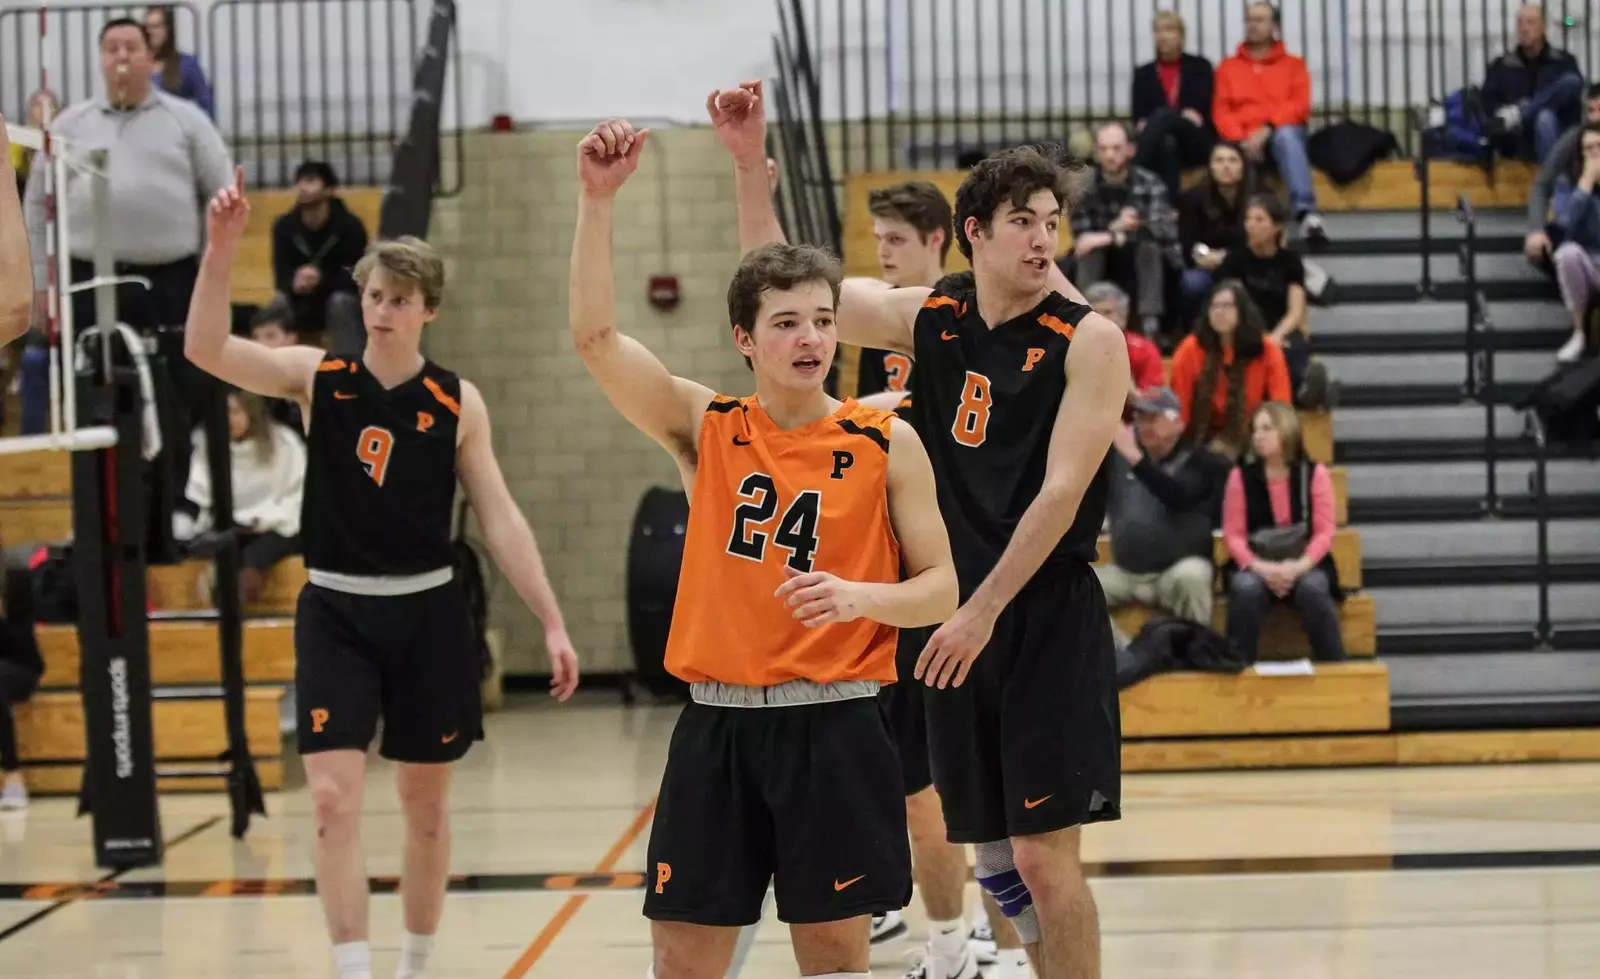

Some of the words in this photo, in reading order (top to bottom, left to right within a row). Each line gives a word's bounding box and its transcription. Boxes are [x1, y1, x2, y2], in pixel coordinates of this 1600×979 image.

[1021, 347, 1046, 372] P
[416, 411, 434, 433] P
[951, 370, 993, 448] 8
[356, 425, 394, 487] 9
[830, 450, 854, 480] P
[726, 471, 822, 574] 24
[310, 708, 329, 733] P
[655, 862, 672, 894] P
